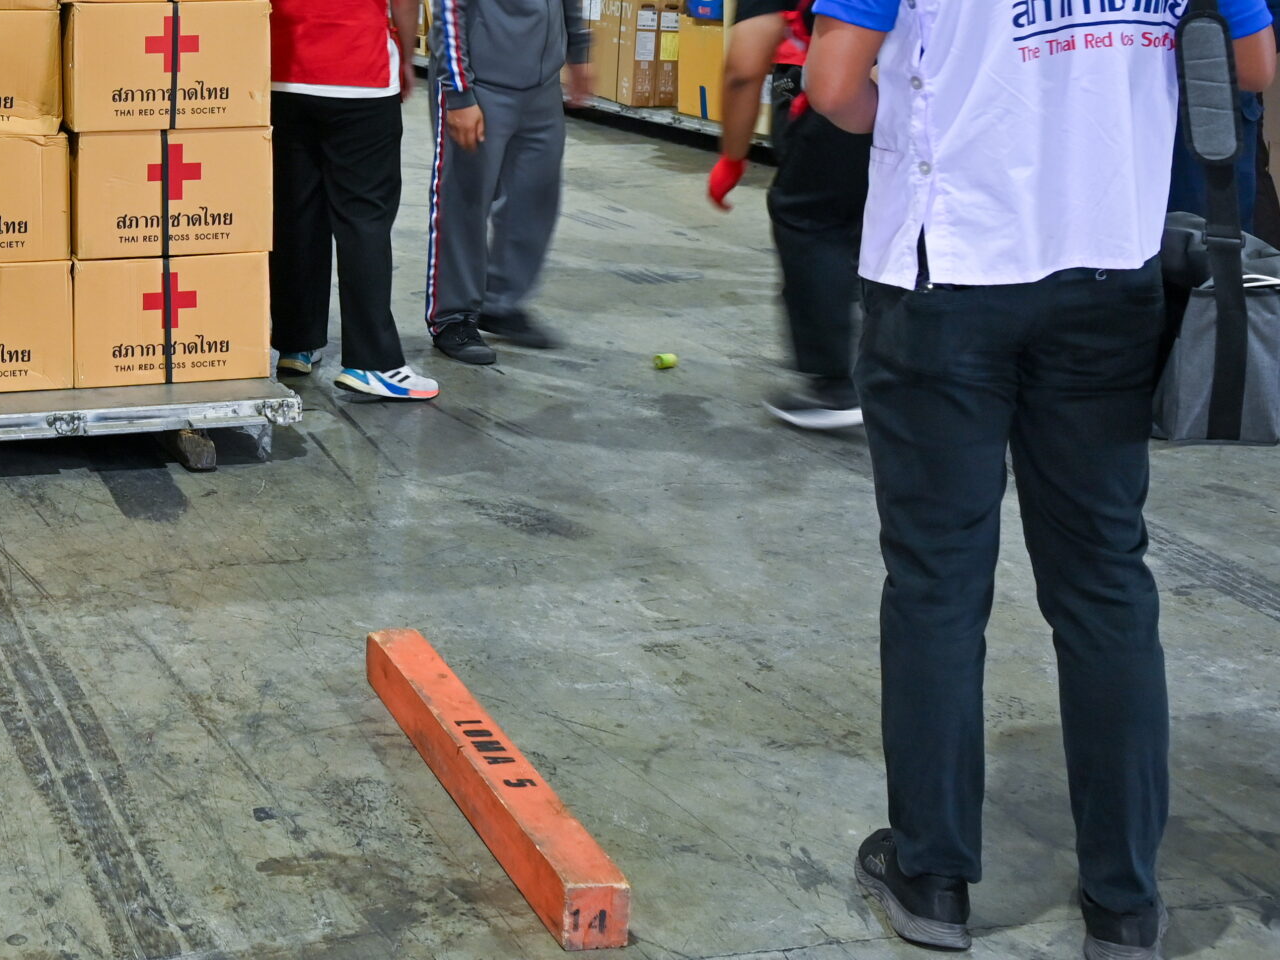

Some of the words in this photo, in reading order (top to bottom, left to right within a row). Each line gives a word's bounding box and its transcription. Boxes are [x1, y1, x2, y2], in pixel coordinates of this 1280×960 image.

[1045, 34, 1076, 56] Thai
[1084, 31, 1113, 49] Red
[114, 109, 134, 117] THAI
[138, 108, 155, 116] RED
[159, 107, 186, 116] CRSS
[190, 106, 226, 115] SOCIETY
[116, 207, 233, 230] สภากชาดไทย
[118, 235, 139, 243] THAI
[142, 235, 159, 243] RED
[169, 233, 190, 242] ROSS
[194, 232, 230, 241] SOCIETY
[114, 364, 135, 372] THAI
[138, 363, 155, 371] RED
[160, 361, 187, 370] COSS
[191, 359, 228, 368] SOCIETY
[454, 719, 516, 765] LOMA
[503, 778, 537, 788] 5
